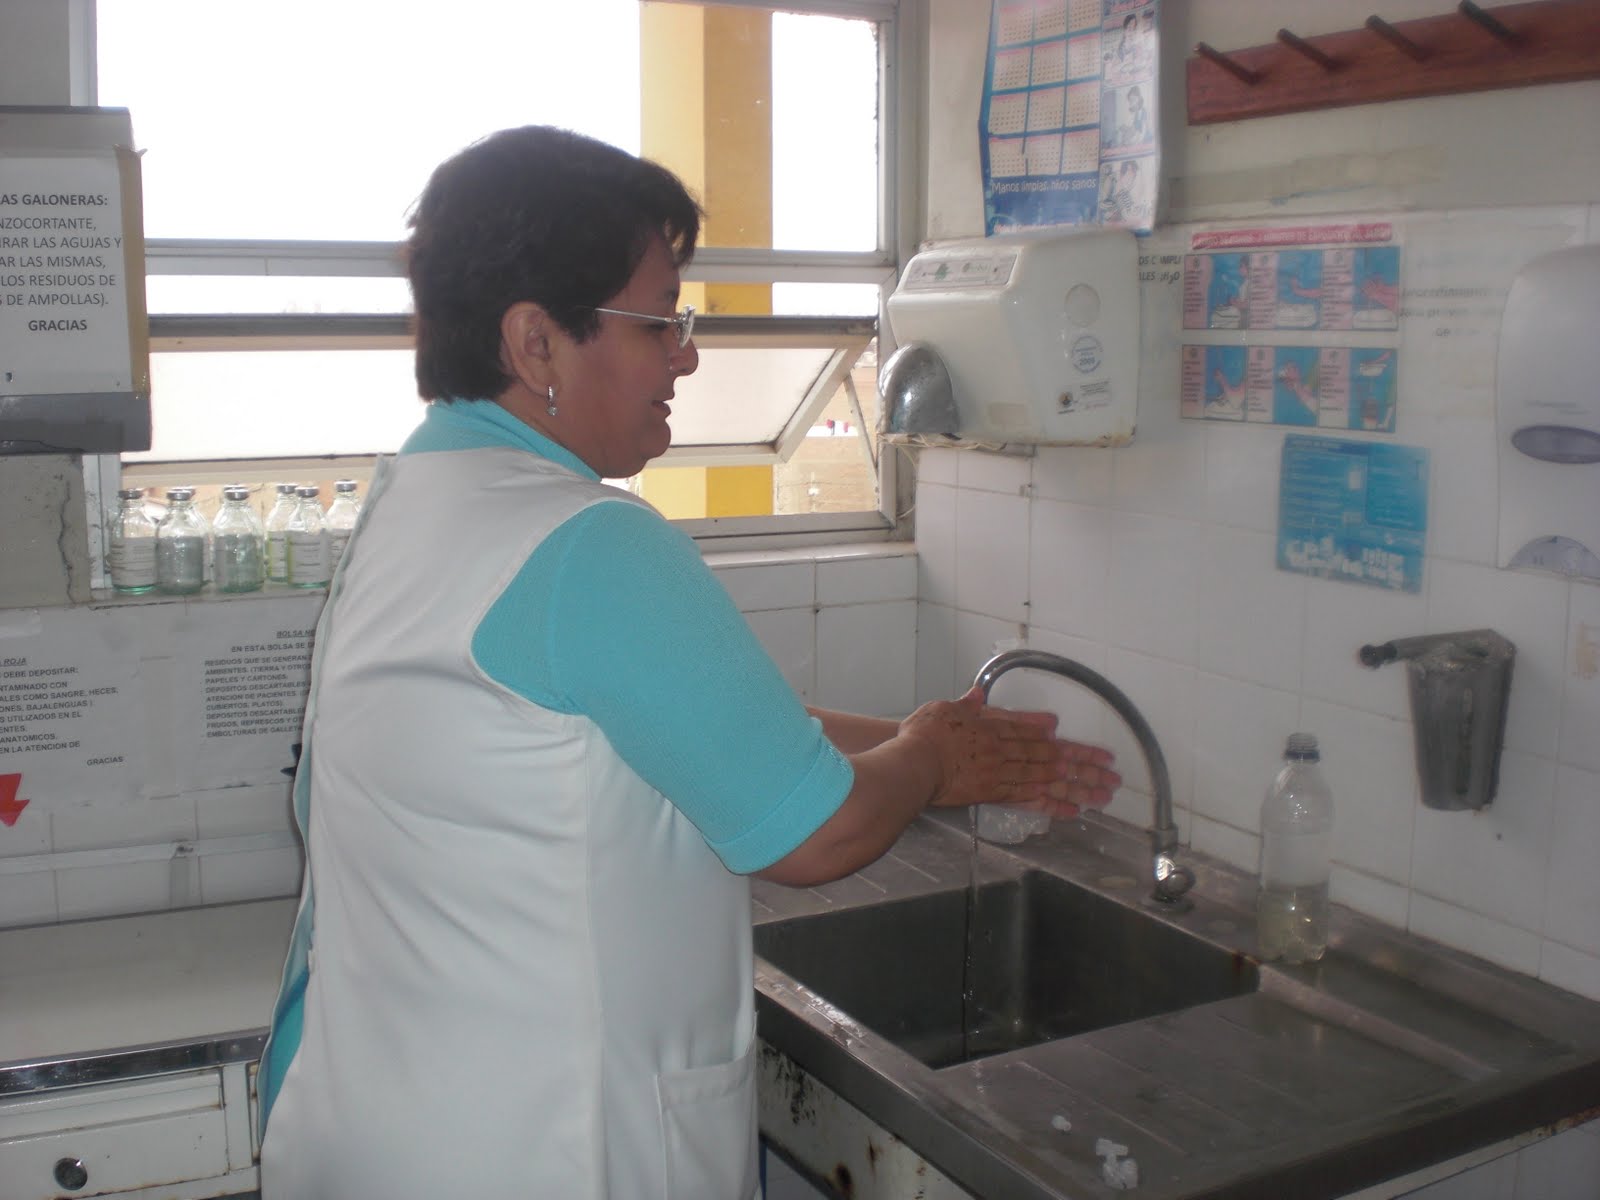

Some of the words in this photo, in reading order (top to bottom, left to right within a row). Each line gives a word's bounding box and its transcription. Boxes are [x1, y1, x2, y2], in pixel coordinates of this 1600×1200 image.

[992, 182, 1020, 194] Manos
[1071, 178, 1096, 190] sanos
[22, 194, 108, 206] GALONERAS:
[33, 236, 57, 249] LAS
[60, 236, 111, 249] AGUJAS
[114, 237, 122, 249] Y
[20, 256, 43, 268] LAS
[47, 256, 107, 269] MISMAS,
[1, 275, 25, 287] LOS
[29, 274, 95, 287] RESIDUOS
[99, 274, 116, 286] DE
[7, 294, 25, 306] DE
[28, 293, 109, 307] AMPOLLAS).
[28, 319, 88, 331] GRACIAS
[276, 629, 303, 639] BOLSA
[231, 645, 242, 653] EN
[244, 644, 266, 652] ESTA
[267, 642, 293, 651] BOLSA
[4, 657, 27, 667] ROJA
[204, 658, 242, 667] RESIDUOS
[243, 657, 260, 665] QUE
[261, 656, 271, 664] SE
[272, 655, 307, 663] GENERAN
[4, 671, 27, 679] DEBE
[29, 666, 79, 678] DEPOSITAR:
[250, 665, 279, 674] (TIERRA
[49, 681, 68, 689] CON
[205, 676, 239, 685] PAPELES
[205, 685, 247, 694] DEPOSITOS
[249, 680, 306, 691] DESCARTABLES
[23, 693, 49, 701] COMO
[206, 694, 243, 703] ATENCION
[26, 700, 88, 711] BAJALENGUAS
[7, 713, 57, 723] UTILIZADOS
[58, 711, 70, 719] EN
[206, 711, 248, 720] DEPOSITOS
[240, 717, 284, 727] REFRESCOS
[207, 728, 257, 738] EMBOLTURAS
[258, 727, 269, 735] DE
[12, 745, 23, 753] LA
[25, 741, 67, 752] ATENCION
[69, 740, 81, 748] DE
[86, 755, 124, 766] GRACIAS
